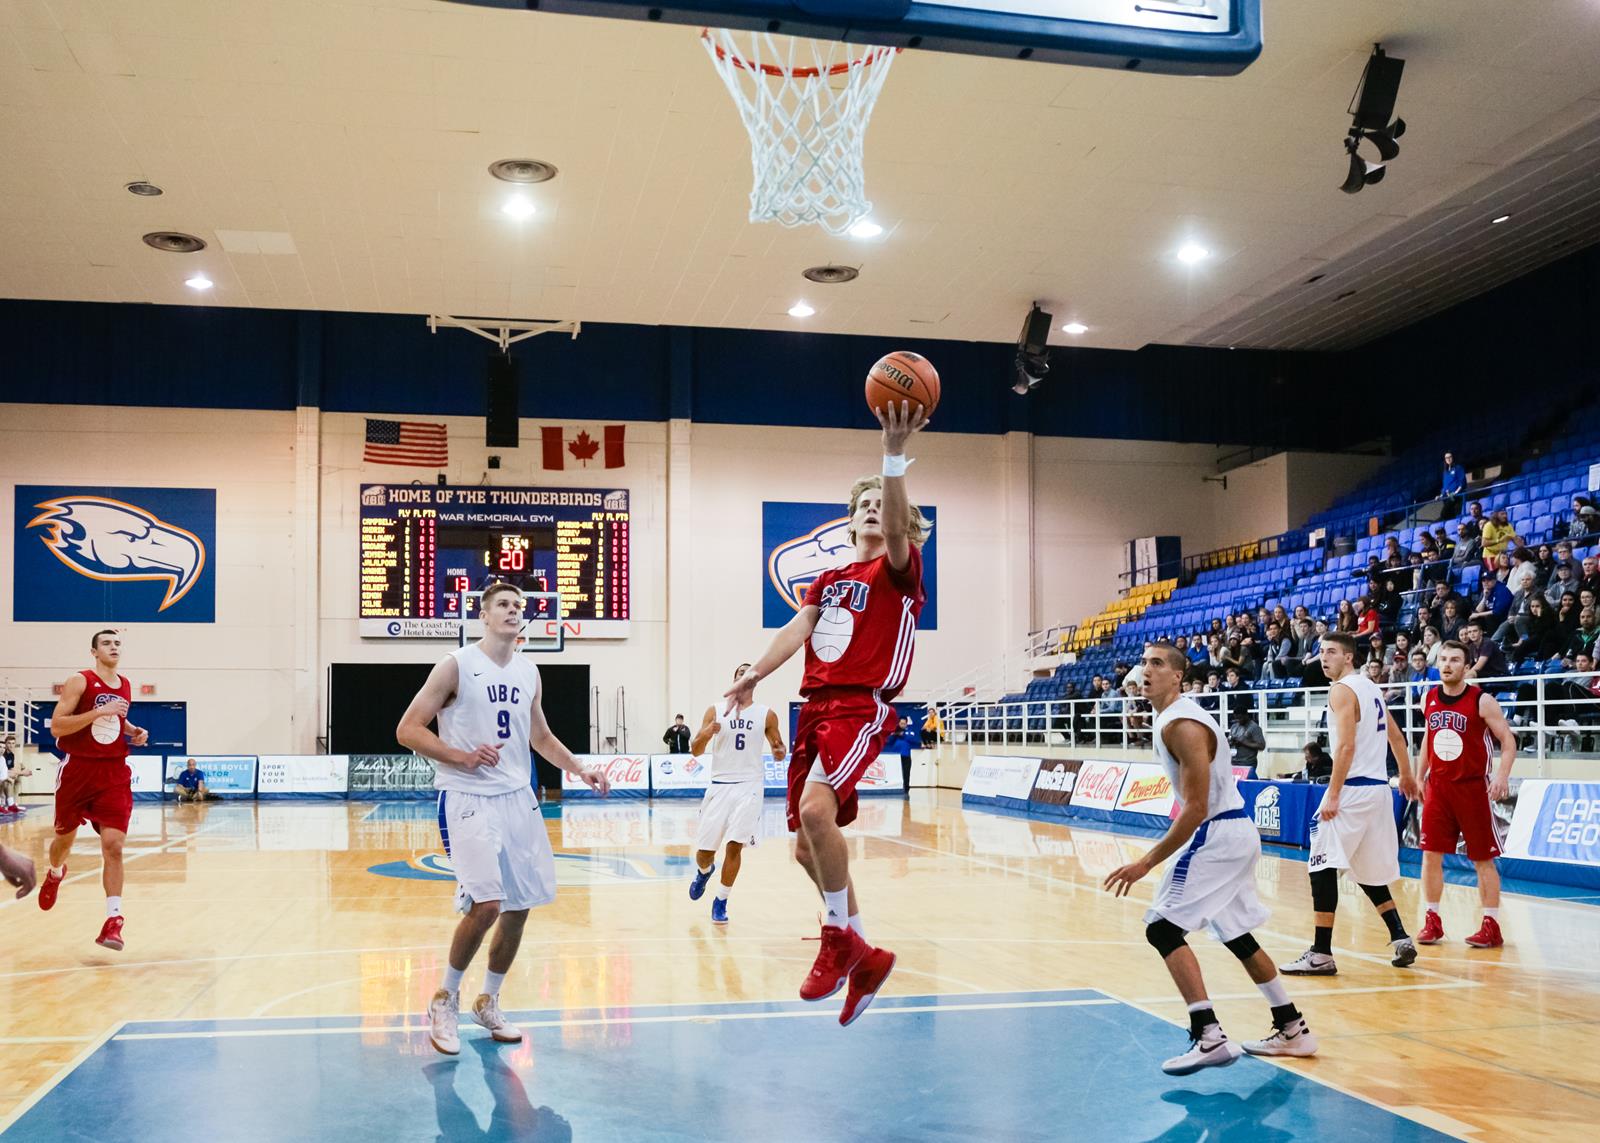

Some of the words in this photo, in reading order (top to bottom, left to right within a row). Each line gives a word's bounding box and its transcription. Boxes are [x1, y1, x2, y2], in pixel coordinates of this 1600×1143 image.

[388, 489, 431, 503] HOME
[435, 490, 454, 503] OF
[456, 490, 487, 504] THE
[490, 491, 602, 506] THUNDERBIRDS
[439, 513, 465, 522] WAR
[467, 514, 527, 523] MEMORIAL
[530, 515, 554, 523] GYM
[501, 537, 529, 550] 6:54
[499, 549, 524, 570] 20
[447, 568, 467, 576] HOME
[455, 577, 469, 592] 13
[819, 580, 870, 612] SFU
[404, 621, 419, 629] The
[420, 621, 442, 630] Coast
[444, 621, 460, 630] Plaz
[545, 621, 581, 636] CN
[487, 684, 520, 704] UBC
[92, 692, 129, 717] SF
[1374, 697, 1386, 732] 2
[497, 710, 511, 739] 9
[729, 718, 754, 731] UBC
[1429, 710, 1467, 733] SFU
[735, 733, 746, 750] 6
[566, 757, 644, 783] Cca-Cola
[1127, 776, 1171, 800] PowerBar
[1254, 805, 1280, 829] UBC
[1547, 821, 1600, 846] 2GO
[1310, 853, 1328, 867] UBC
